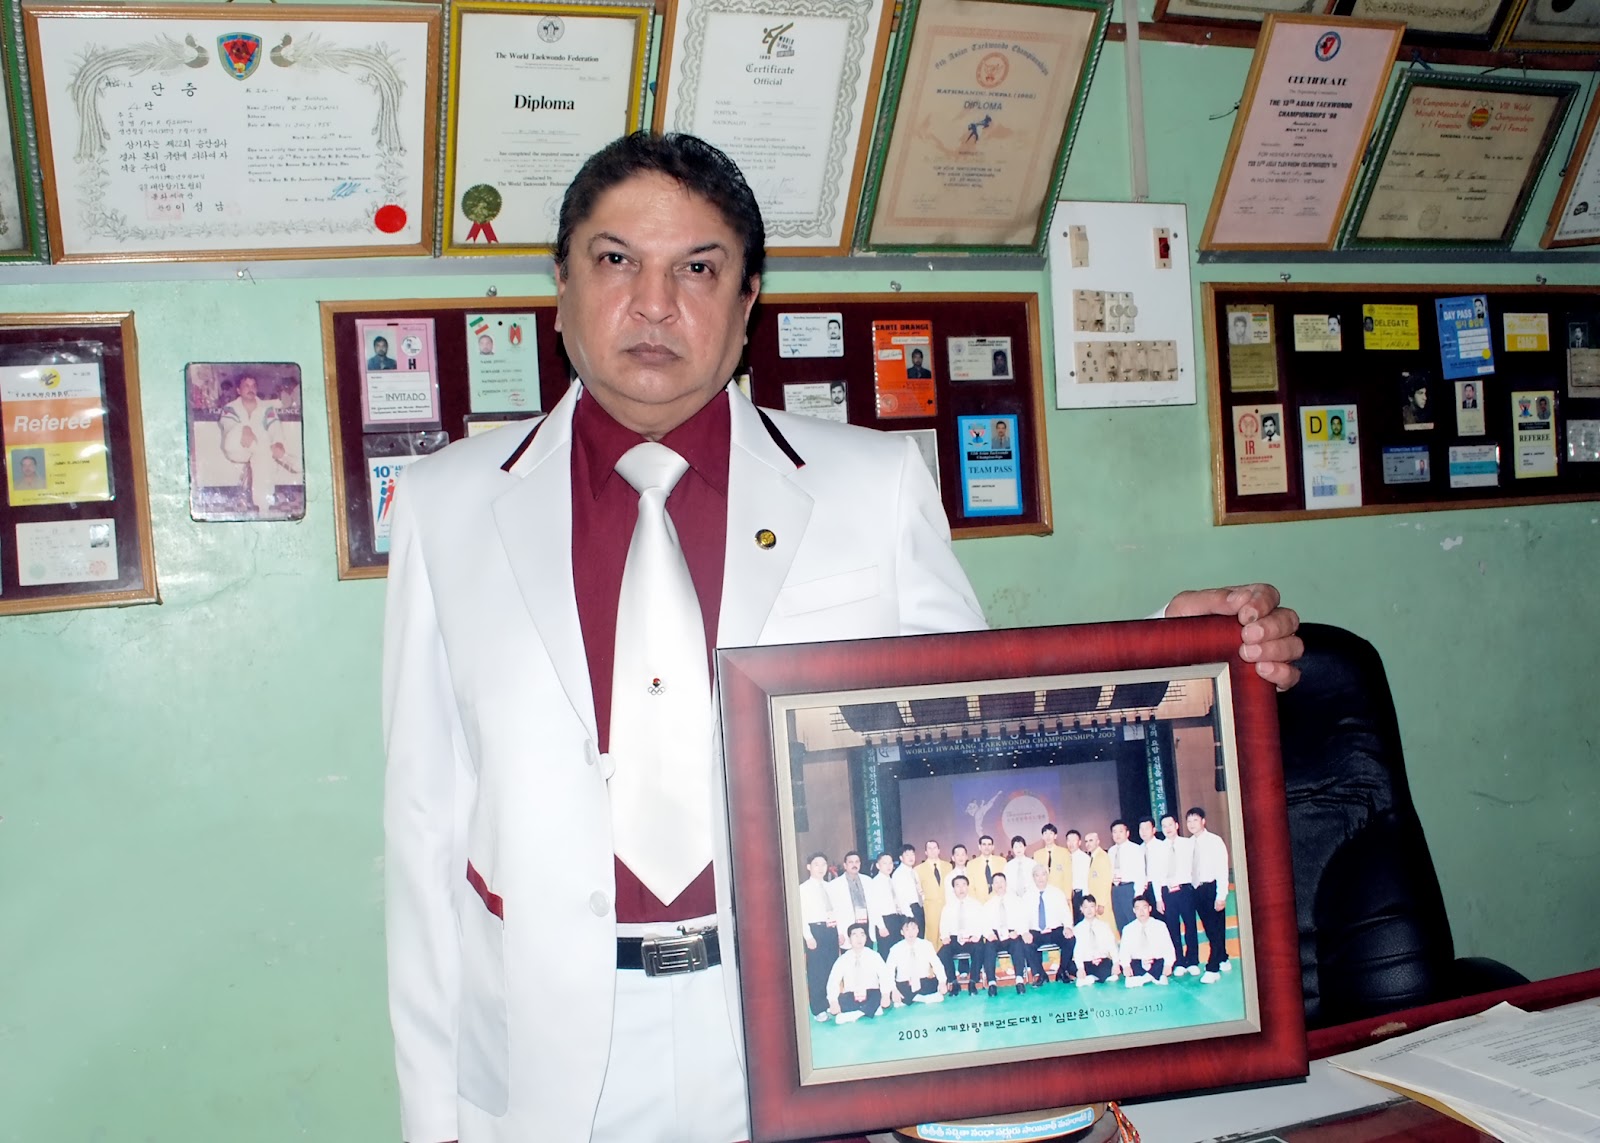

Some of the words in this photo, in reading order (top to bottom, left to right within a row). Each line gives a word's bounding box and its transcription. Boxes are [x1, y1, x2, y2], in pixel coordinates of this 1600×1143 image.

[510, 52, 529, 60] World
[532, 53, 566, 61] Taekwondo
[971, 42, 1009, 51] Taekwondo
[1011, 44, 1049, 76] Championships
[745, 63, 795, 74] Certificate
[753, 78, 783, 86] Official
[151, 82, 165, 96] 단
[181, 82, 198, 97] 증
[514, 94, 575, 112] Diploma
[963, 100, 1003, 110] DIPLOMA
[1316, 101, 1353, 109] TAEKWONDO
[1278, 111, 1326, 119] CHAMPIONSHIPS
[1443, 310, 1456, 320] DAY
[1457, 309, 1473, 319] PASS
[1375, 319, 1409, 328] DELEGATE
[408, 358, 416, 370] H
[385, 393, 426, 401] INVITADO
[13, 415, 92, 433] Referee
[1310, 416, 1322, 434] D
[1519, 434, 1550, 442] REFEREE
[1245, 440, 1256, 455] IR
[969, 466, 992, 474] TEAM
[994, 465, 1013, 473] PASS
[905, 747, 933, 756] WORLD
[936, 744, 976, 753] HWARANG
[980, 738, 1030, 749] TAEKWONDO
[1032, 733, 1095, 744] CHAMPIONSHIPS
[1098, 731, 1116, 739] 2003
[899, 1029, 928, 1041] 2003
[936, 1014, 1042, 1033] 세계화랑태권도대회
